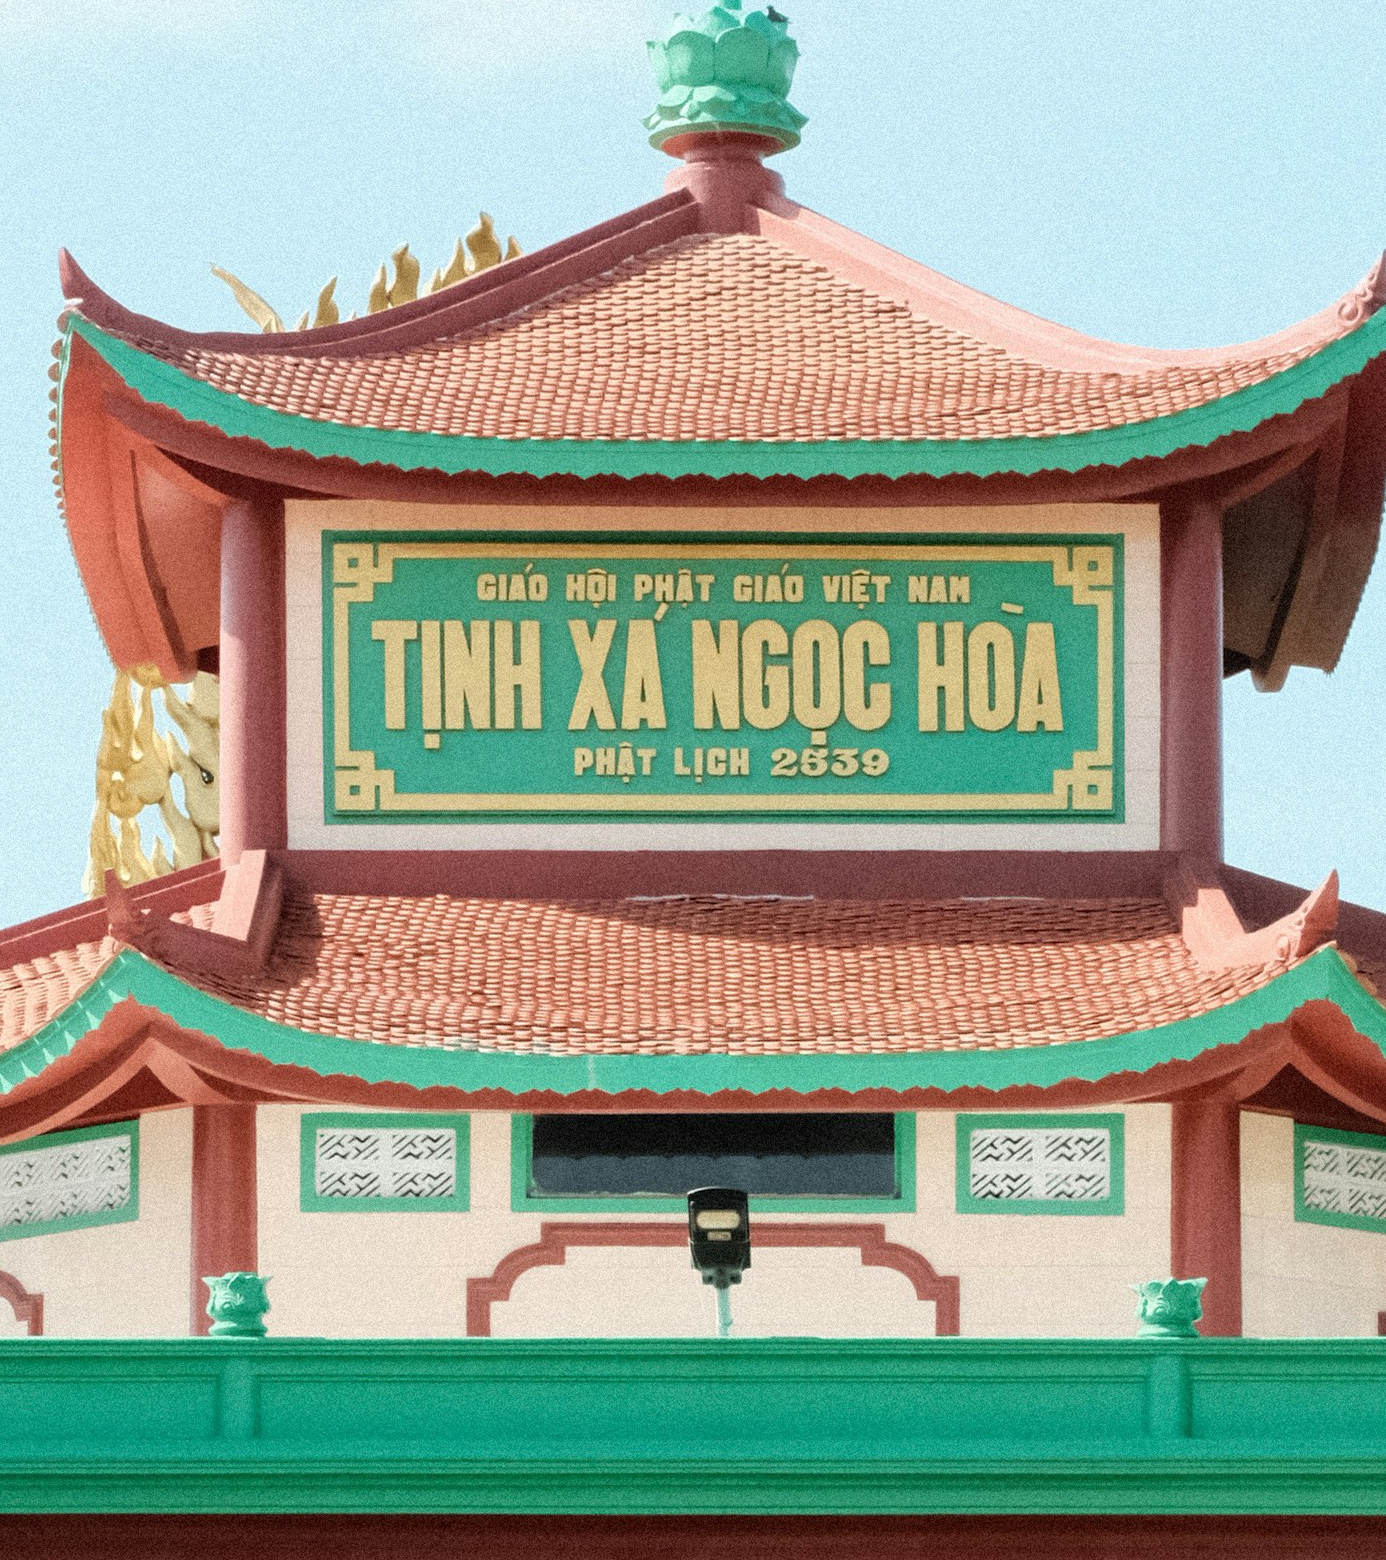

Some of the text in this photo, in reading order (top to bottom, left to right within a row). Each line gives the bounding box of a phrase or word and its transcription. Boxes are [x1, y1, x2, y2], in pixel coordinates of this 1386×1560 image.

[476, 562, 970, 609] GIÁO HỘI PHẬT GIÁO VIỆT NAM
[371, 619, 542, 749] TỊNH
[568, 602, 669, 730] XÁ
[691, 619, 892, 745] NGỌC
[574, 741, 889, 783] PHẬT LỊCH 2539
